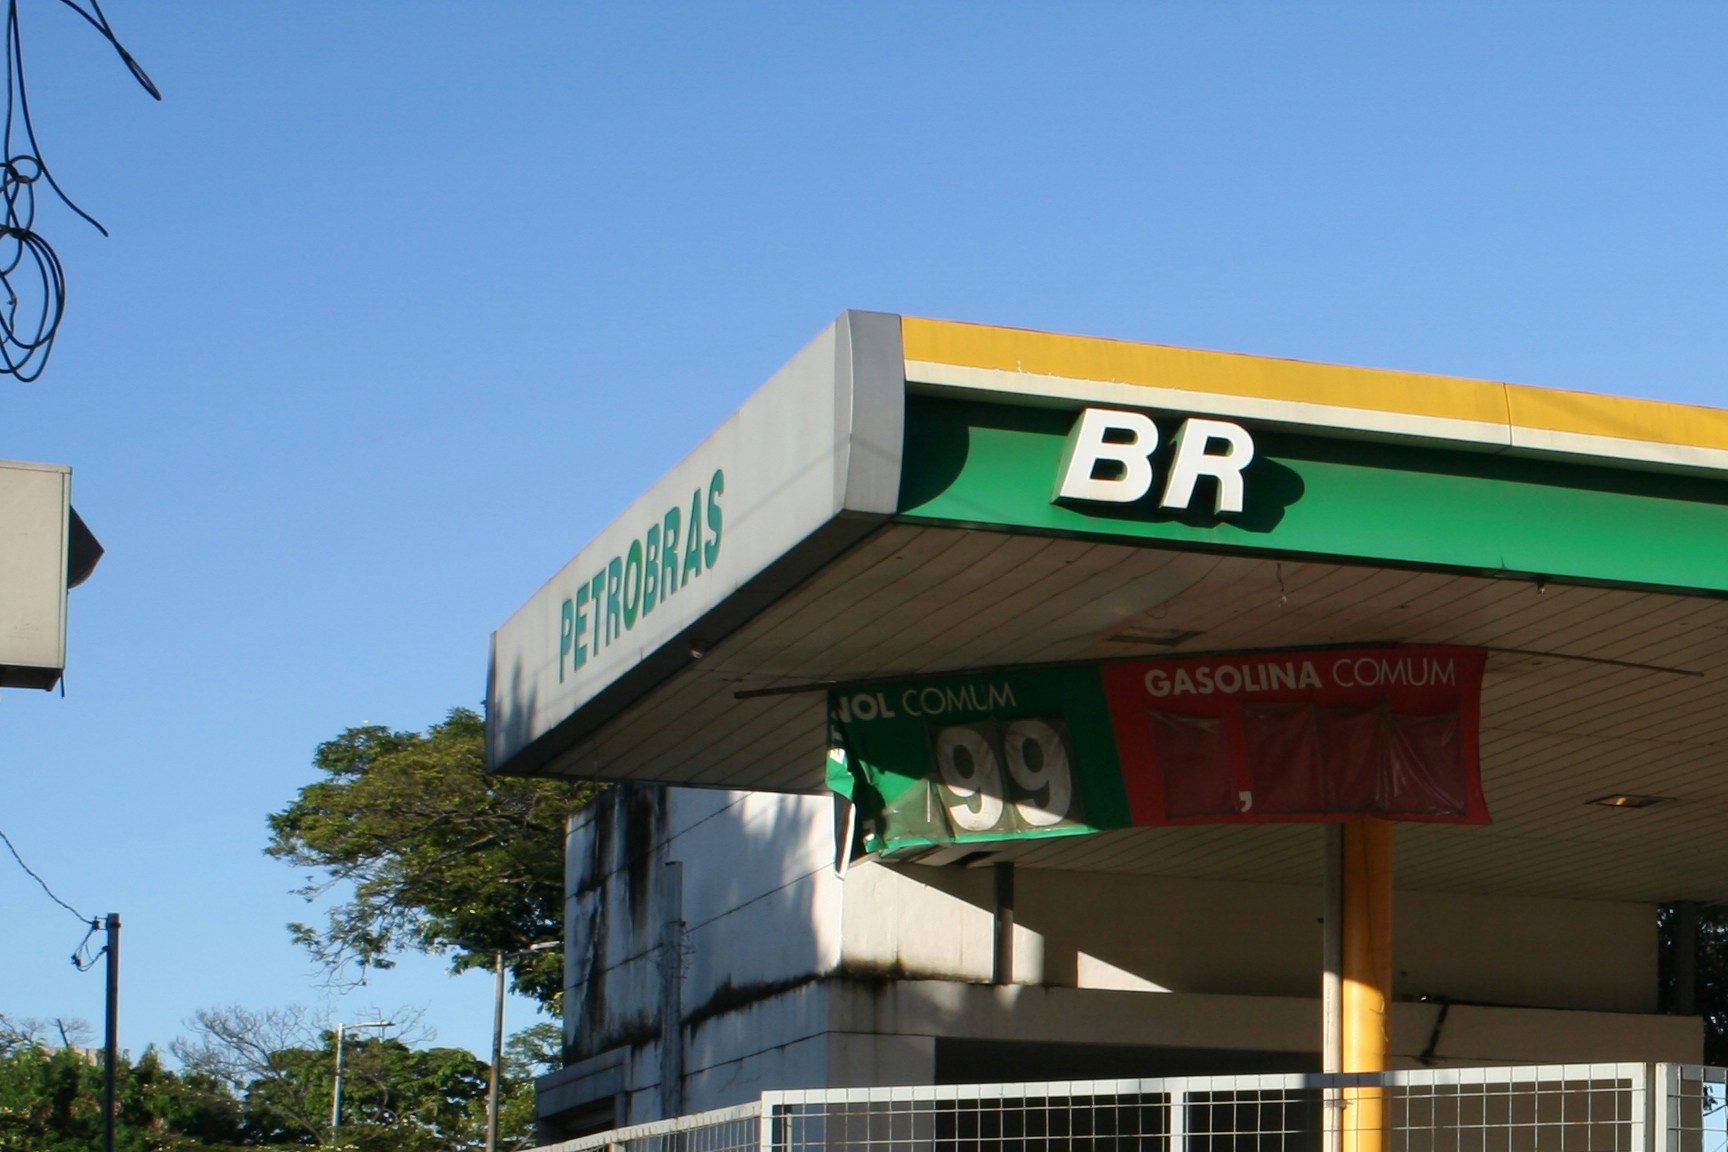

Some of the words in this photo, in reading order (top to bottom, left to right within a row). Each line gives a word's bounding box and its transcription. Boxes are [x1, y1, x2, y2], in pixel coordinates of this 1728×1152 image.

[1053, 408, 1255, 513] BR
[559, 469, 725, 684] PETROBRAS
[902, 680, 1018, 718] COMUM
[1144, 660, 1323, 698] GASOLINA
[1332, 656, 1457, 688] COMUM
